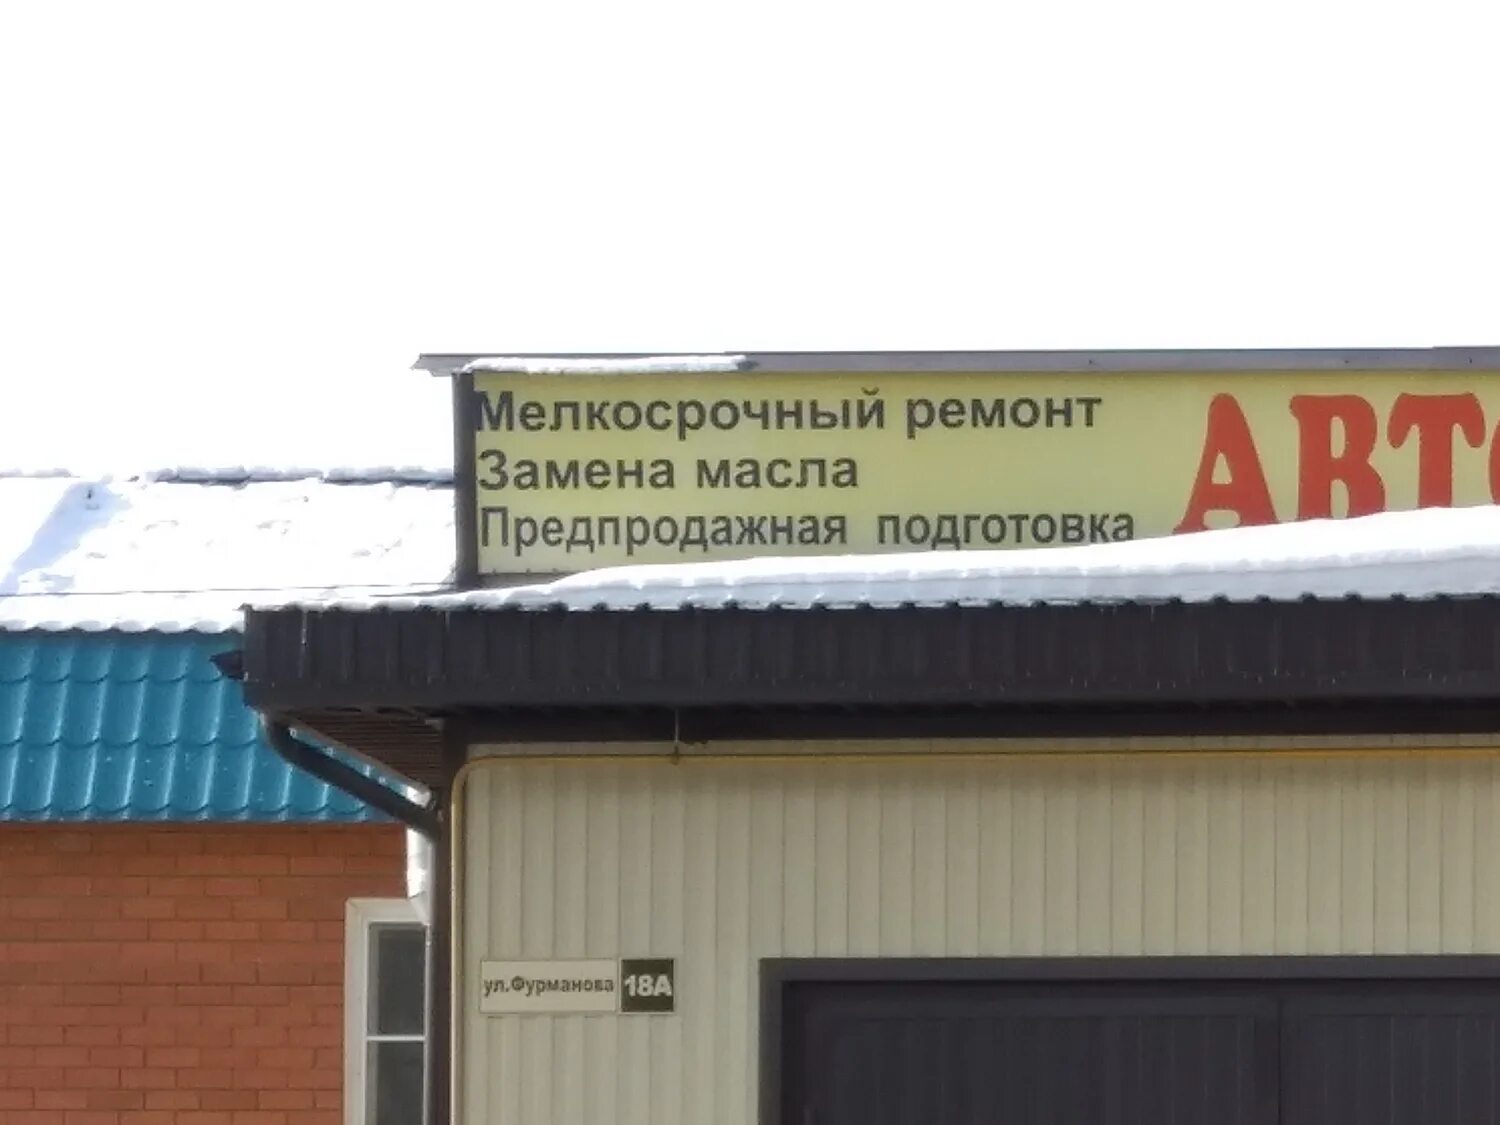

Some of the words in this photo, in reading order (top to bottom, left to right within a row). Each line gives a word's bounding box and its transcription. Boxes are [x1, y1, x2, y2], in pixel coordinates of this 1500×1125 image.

[476, 388, 885, 440] Мелкосрочный
[905, 396, 1102, 439] ремонт
[478, 449, 675, 490] Замена
[696, 453, 859, 490] масла
[480, 508, 848, 555] Предпродажная
[876, 510, 1136, 548] подготовка
[624, 974, 673, 997] 18А
